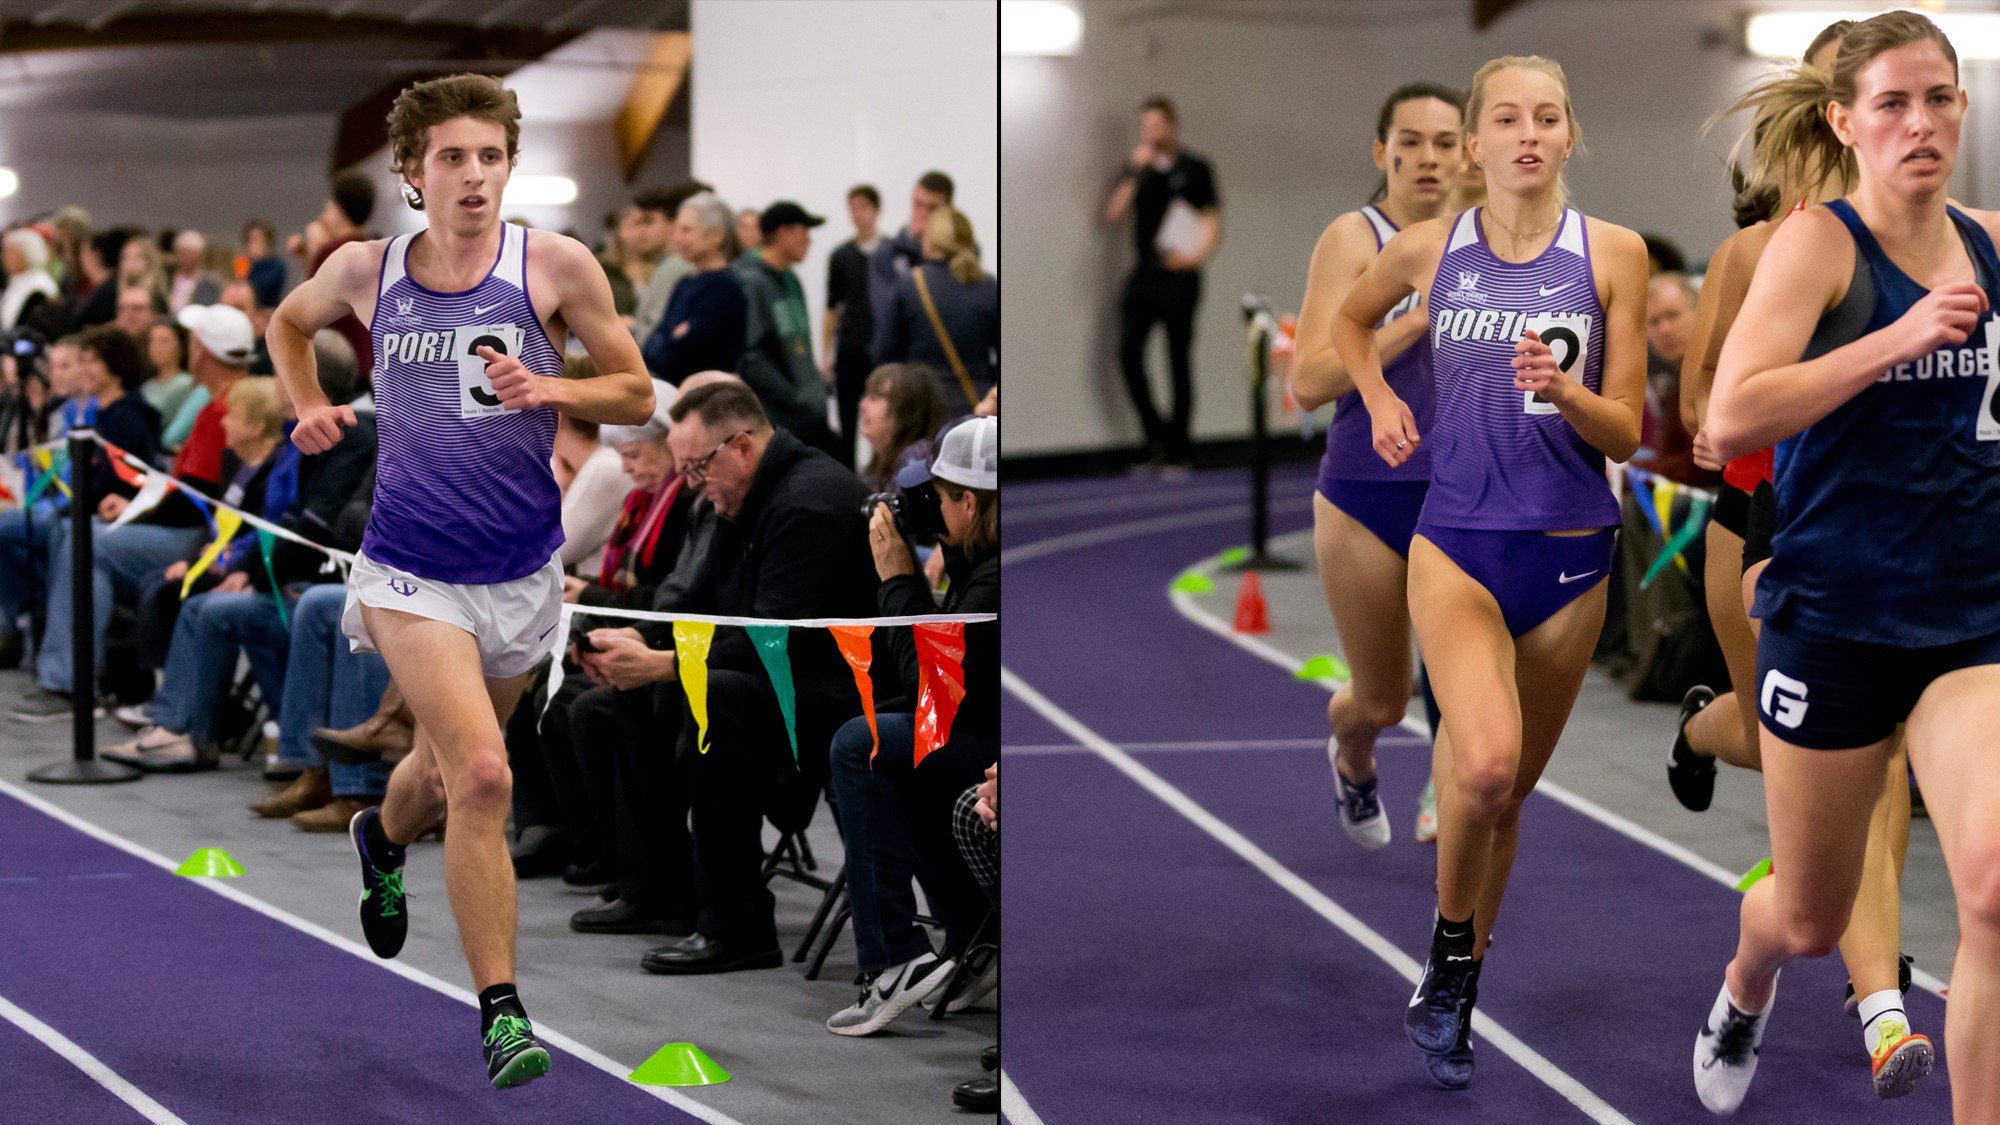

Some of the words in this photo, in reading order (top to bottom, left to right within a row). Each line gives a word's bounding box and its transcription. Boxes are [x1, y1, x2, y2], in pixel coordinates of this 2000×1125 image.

[1435, 309, 1593, 349] PORTLD
[1532, 326, 1580, 403] 2
[467, 335, 508, 406] 3
